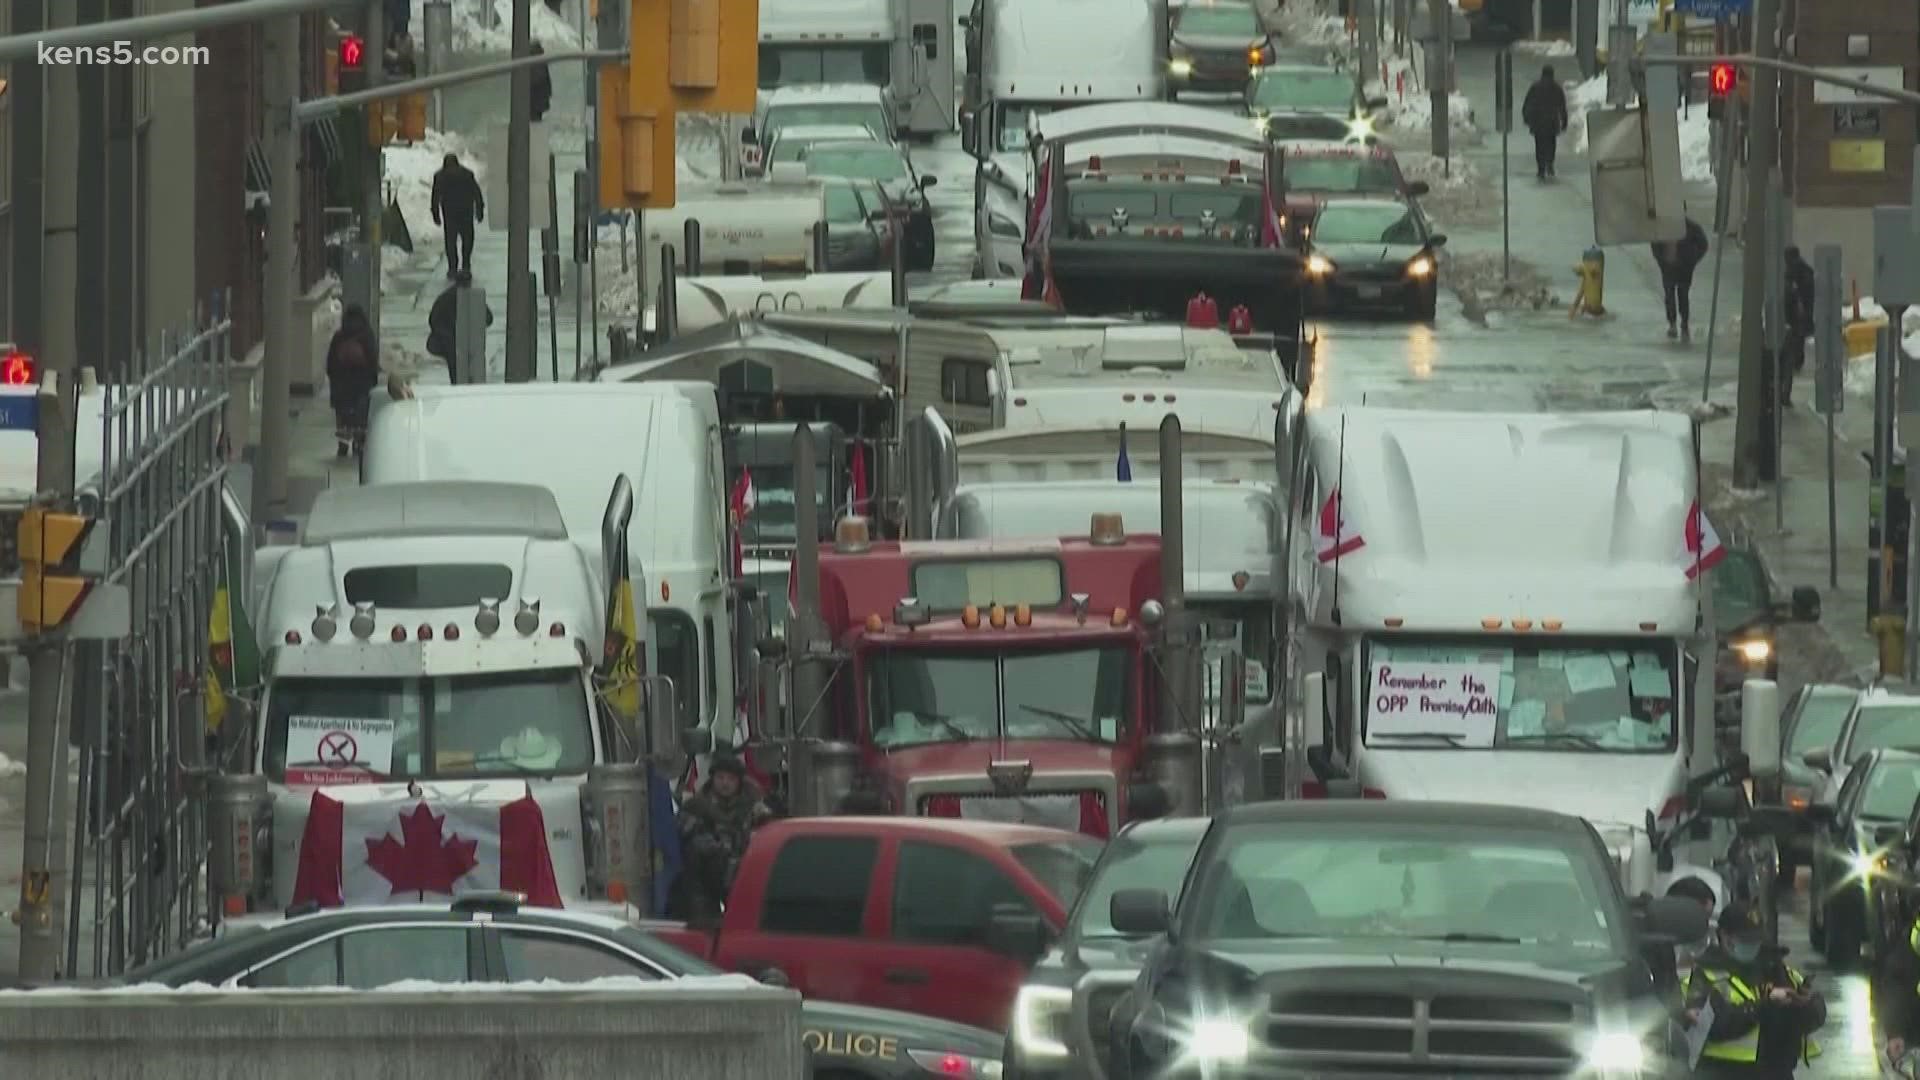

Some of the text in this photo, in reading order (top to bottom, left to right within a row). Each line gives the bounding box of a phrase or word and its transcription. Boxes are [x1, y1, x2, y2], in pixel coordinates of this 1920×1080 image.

[1379, 665, 1486, 694] Remember the
[1376, 695, 1409, 714] OPP
[802, 1030, 898, 1061] OLICE
